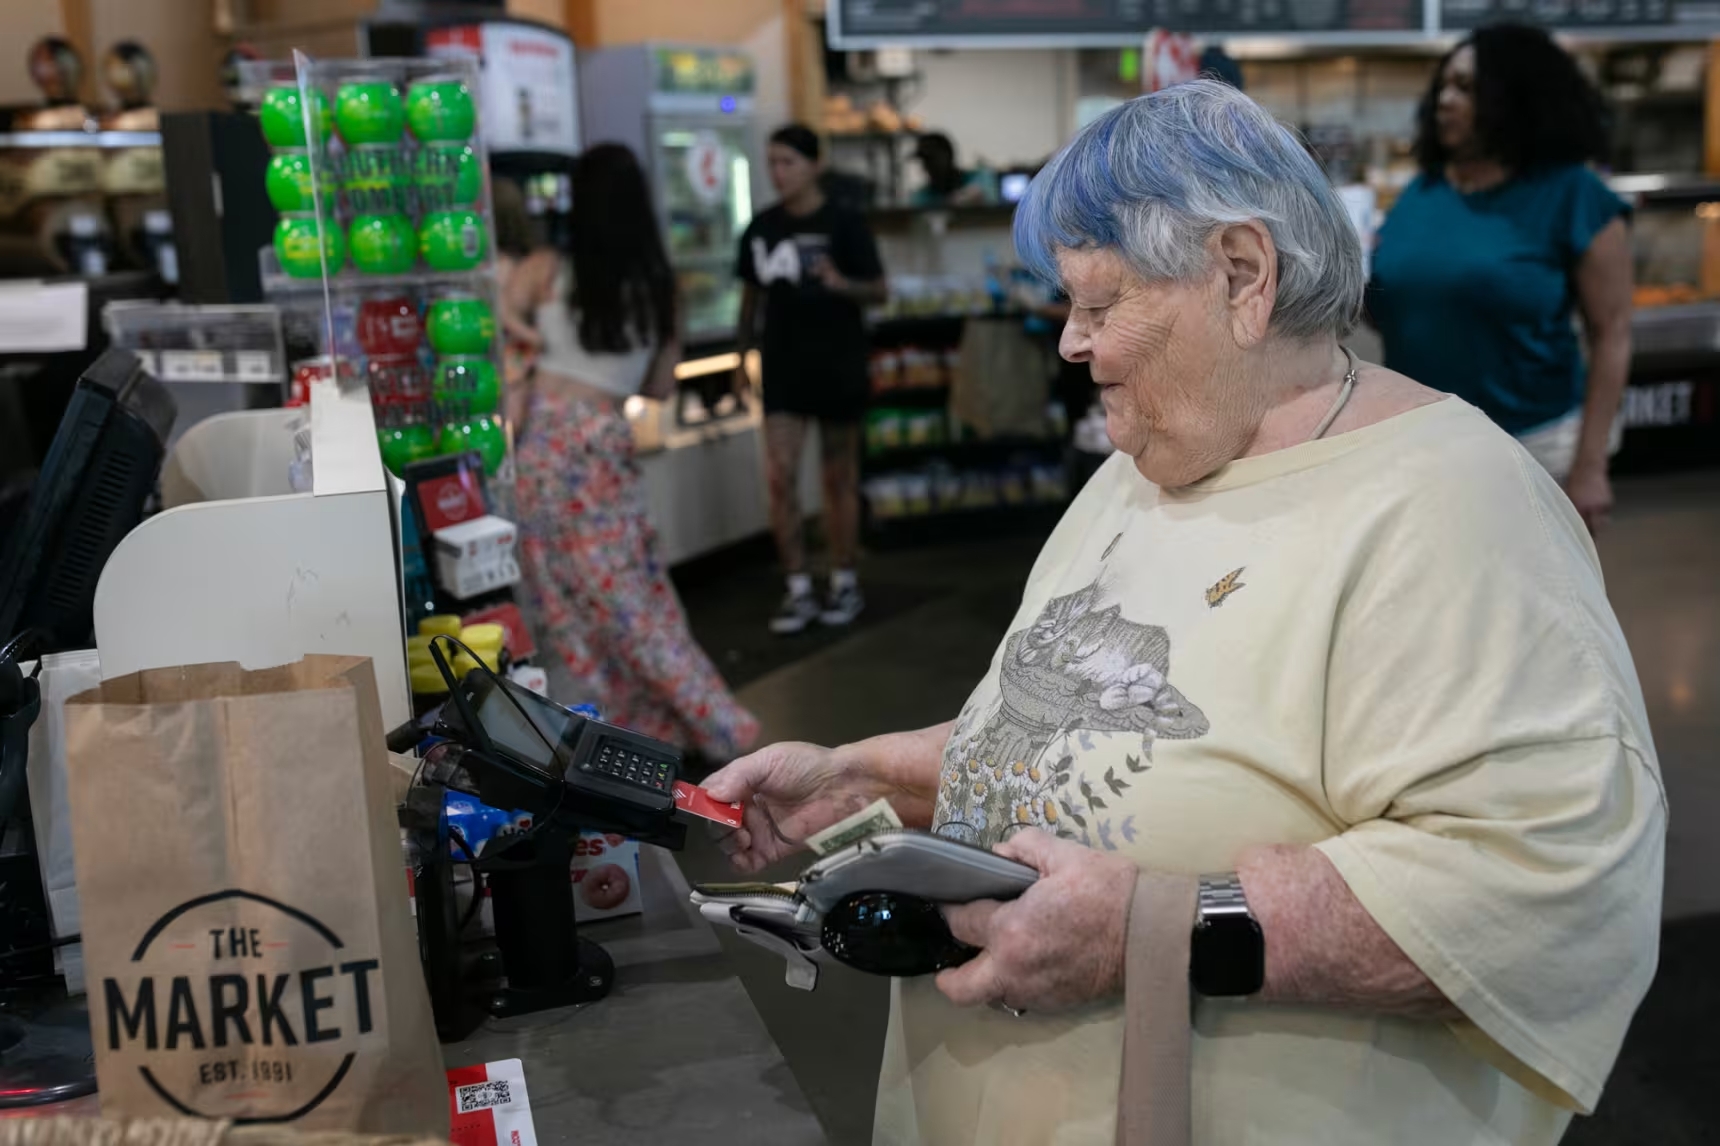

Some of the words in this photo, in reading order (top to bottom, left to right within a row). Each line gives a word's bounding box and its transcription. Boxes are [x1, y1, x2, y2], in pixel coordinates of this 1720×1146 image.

[575, 838, 604, 857] es
[209, 927, 263, 960] THE
[103, 959, 379, 1050] MARKET
[200, 1059, 246, 1085] EST.
[252, 1061, 293, 1083] 1991
